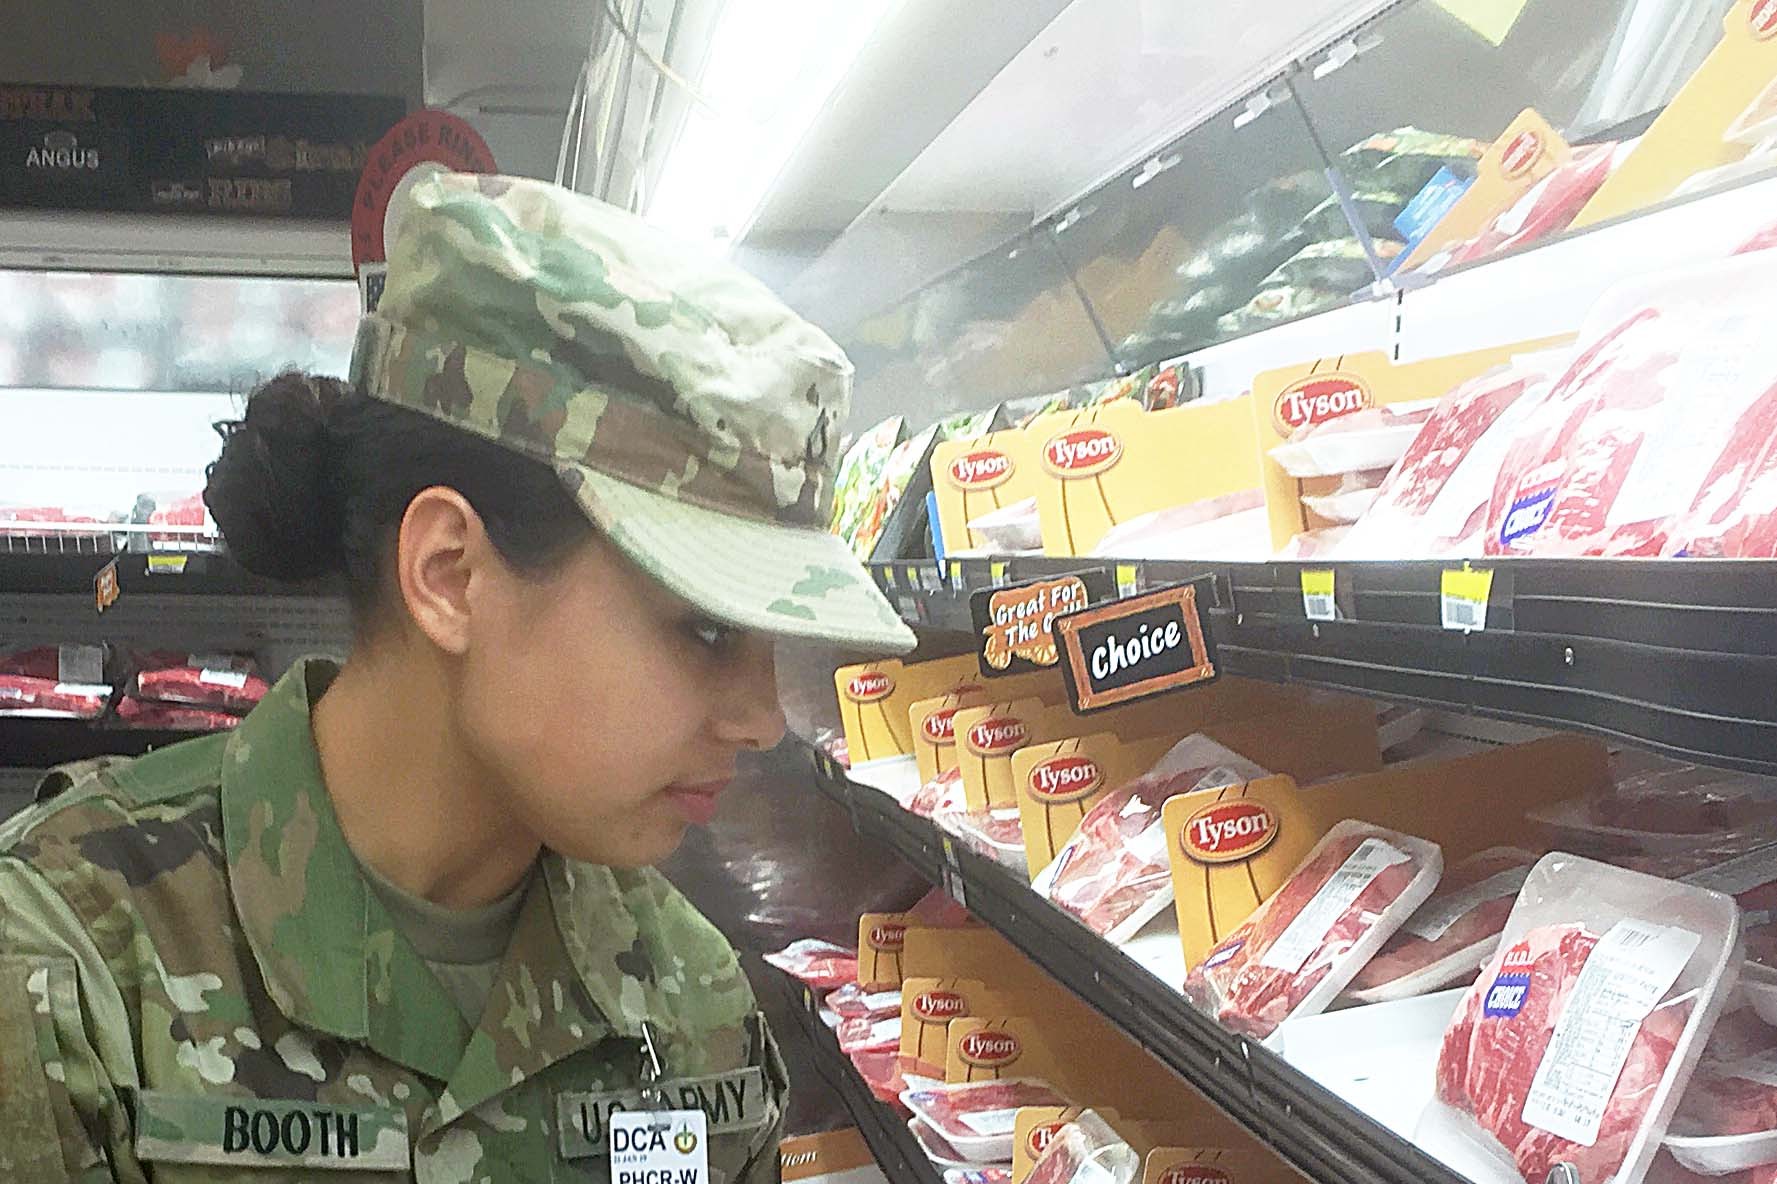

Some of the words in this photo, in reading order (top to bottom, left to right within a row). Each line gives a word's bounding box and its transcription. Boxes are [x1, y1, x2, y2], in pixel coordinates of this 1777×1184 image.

[26, 146, 99, 169] ANGUS
[1282, 389, 1364, 431] Tyson
[1050, 436, 1116, 469] Tyson
[955, 457, 1010, 483] Tyson
[994, 592, 1046, 627] Great
[1051, 580, 1082, 608] For
[1005, 622, 1038, 648] The
[1091, 620, 1182, 681] Choice
[849, 676, 890, 696] Tyson
[972, 723, 1026, 748] Tyson
[1033, 761, 1098, 794] Tyson
[1192, 813, 1269, 851] Tyson
[917, 992, 965, 1016] Tyson
[965, 1034, 1016, 1057] Tyson
[223, 1105, 360, 1158] BOOTH
[613, 1126, 668, 1153] DCA
